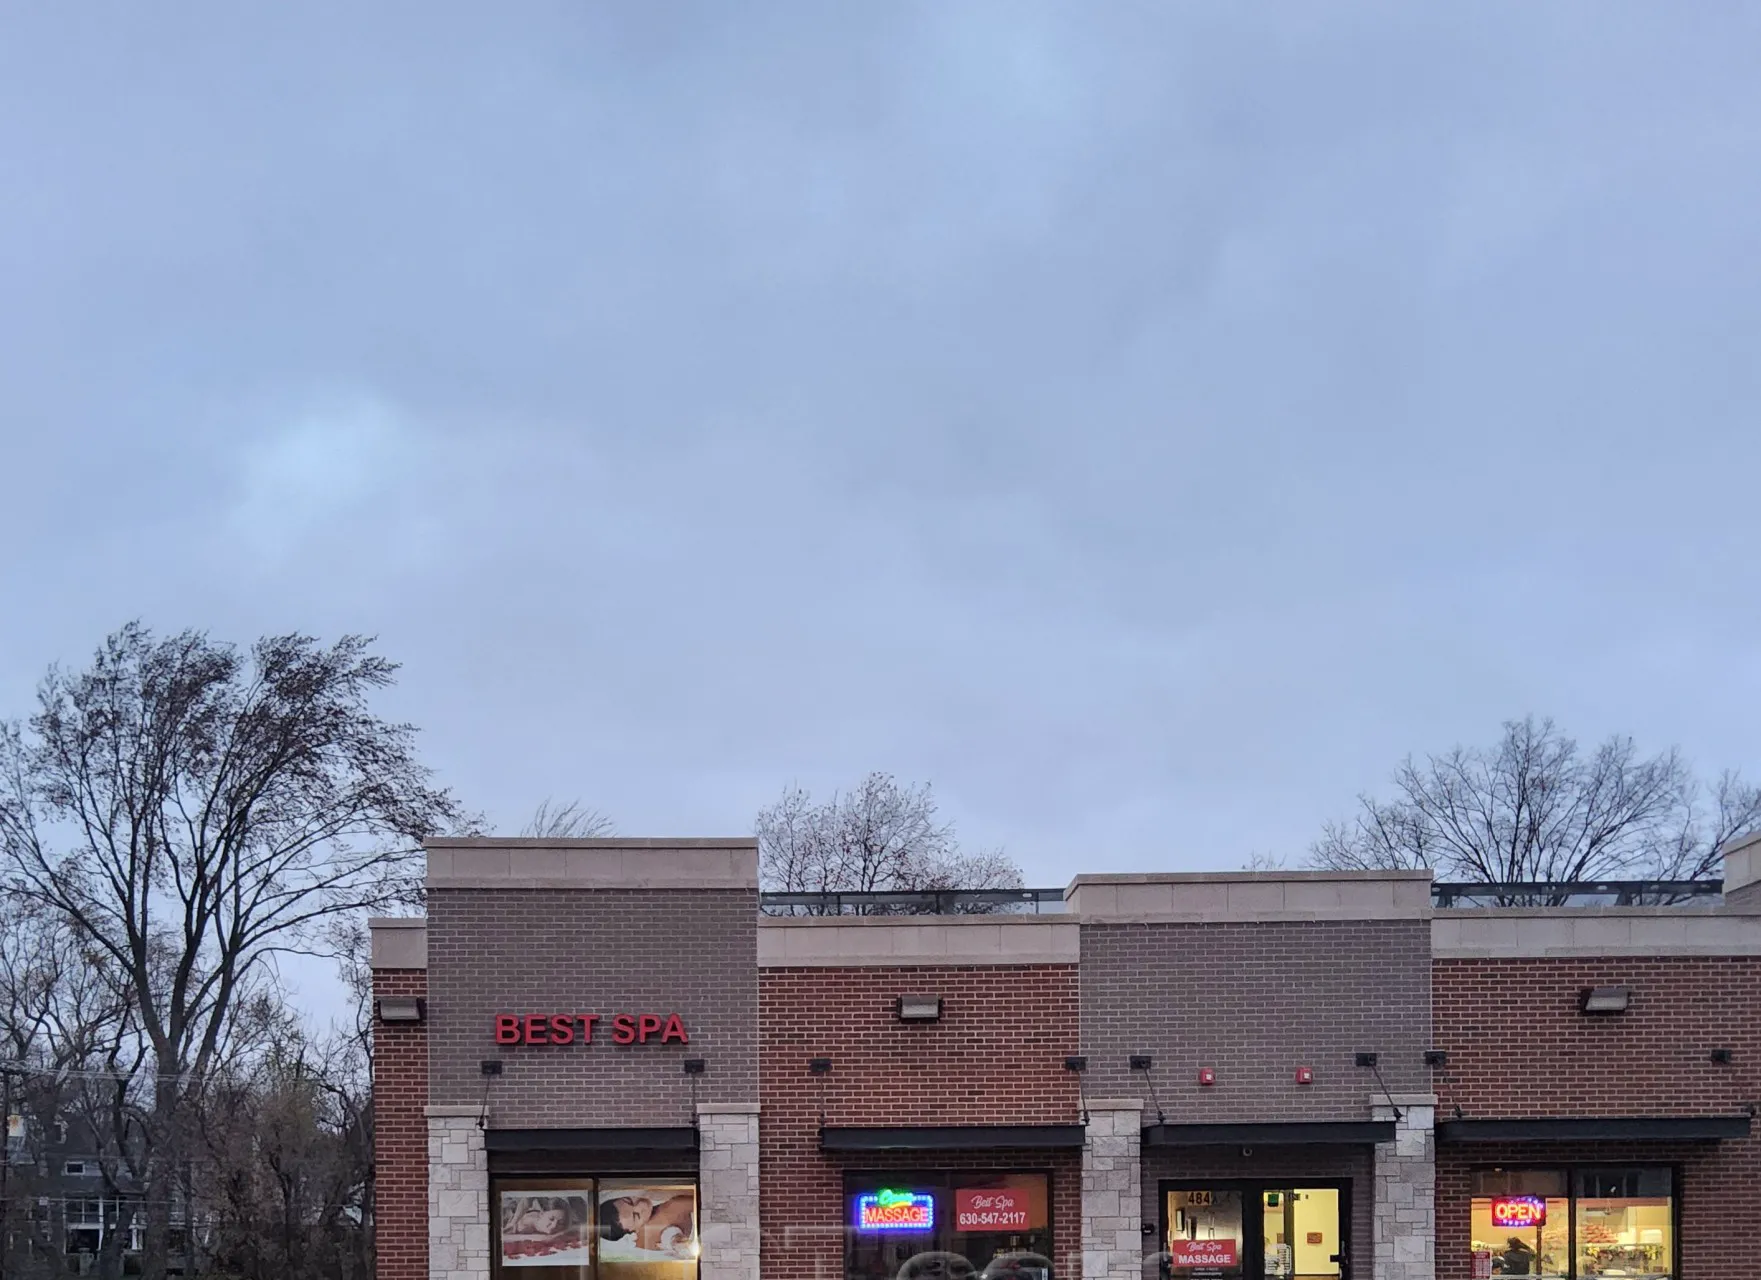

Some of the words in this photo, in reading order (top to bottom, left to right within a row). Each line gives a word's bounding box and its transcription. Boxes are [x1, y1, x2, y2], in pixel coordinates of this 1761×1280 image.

[495, 1013, 599, 1045] BEST
[612, 1013, 689, 1045] SPA
[971, 1195, 994, 1209] Best
[995, 1195, 1014, 1211] Spa
[1496, 1203, 1542, 1219] OPEN
[865, 1206, 929, 1223] MASSAGE
[959, 1212, 1026, 1225] 630-547-2117
[1206, 1241, 1222, 1253] Spa
[1178, 1254, 1231, 1264] MASSAGE
